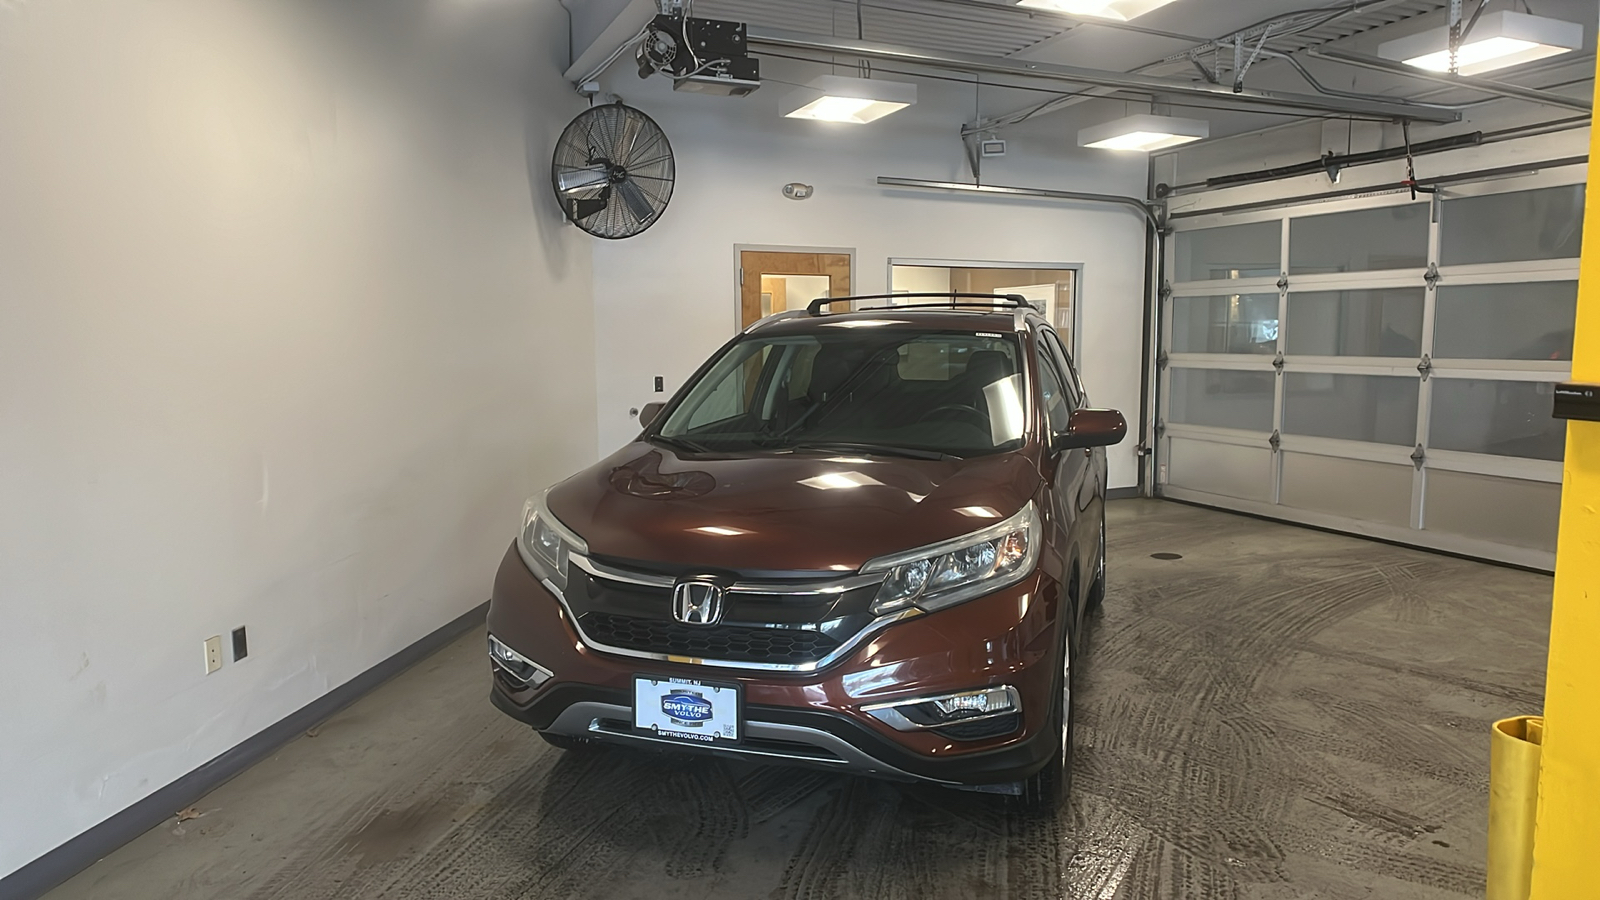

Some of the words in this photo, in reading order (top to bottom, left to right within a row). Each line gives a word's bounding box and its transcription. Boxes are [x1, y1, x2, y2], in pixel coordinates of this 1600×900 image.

[663, 702, 709, 714] SMYTHE
[674, 710, 702, 718] VOLVO
[657, 730, 714, 742] SMYTHEVOLVO.COM
